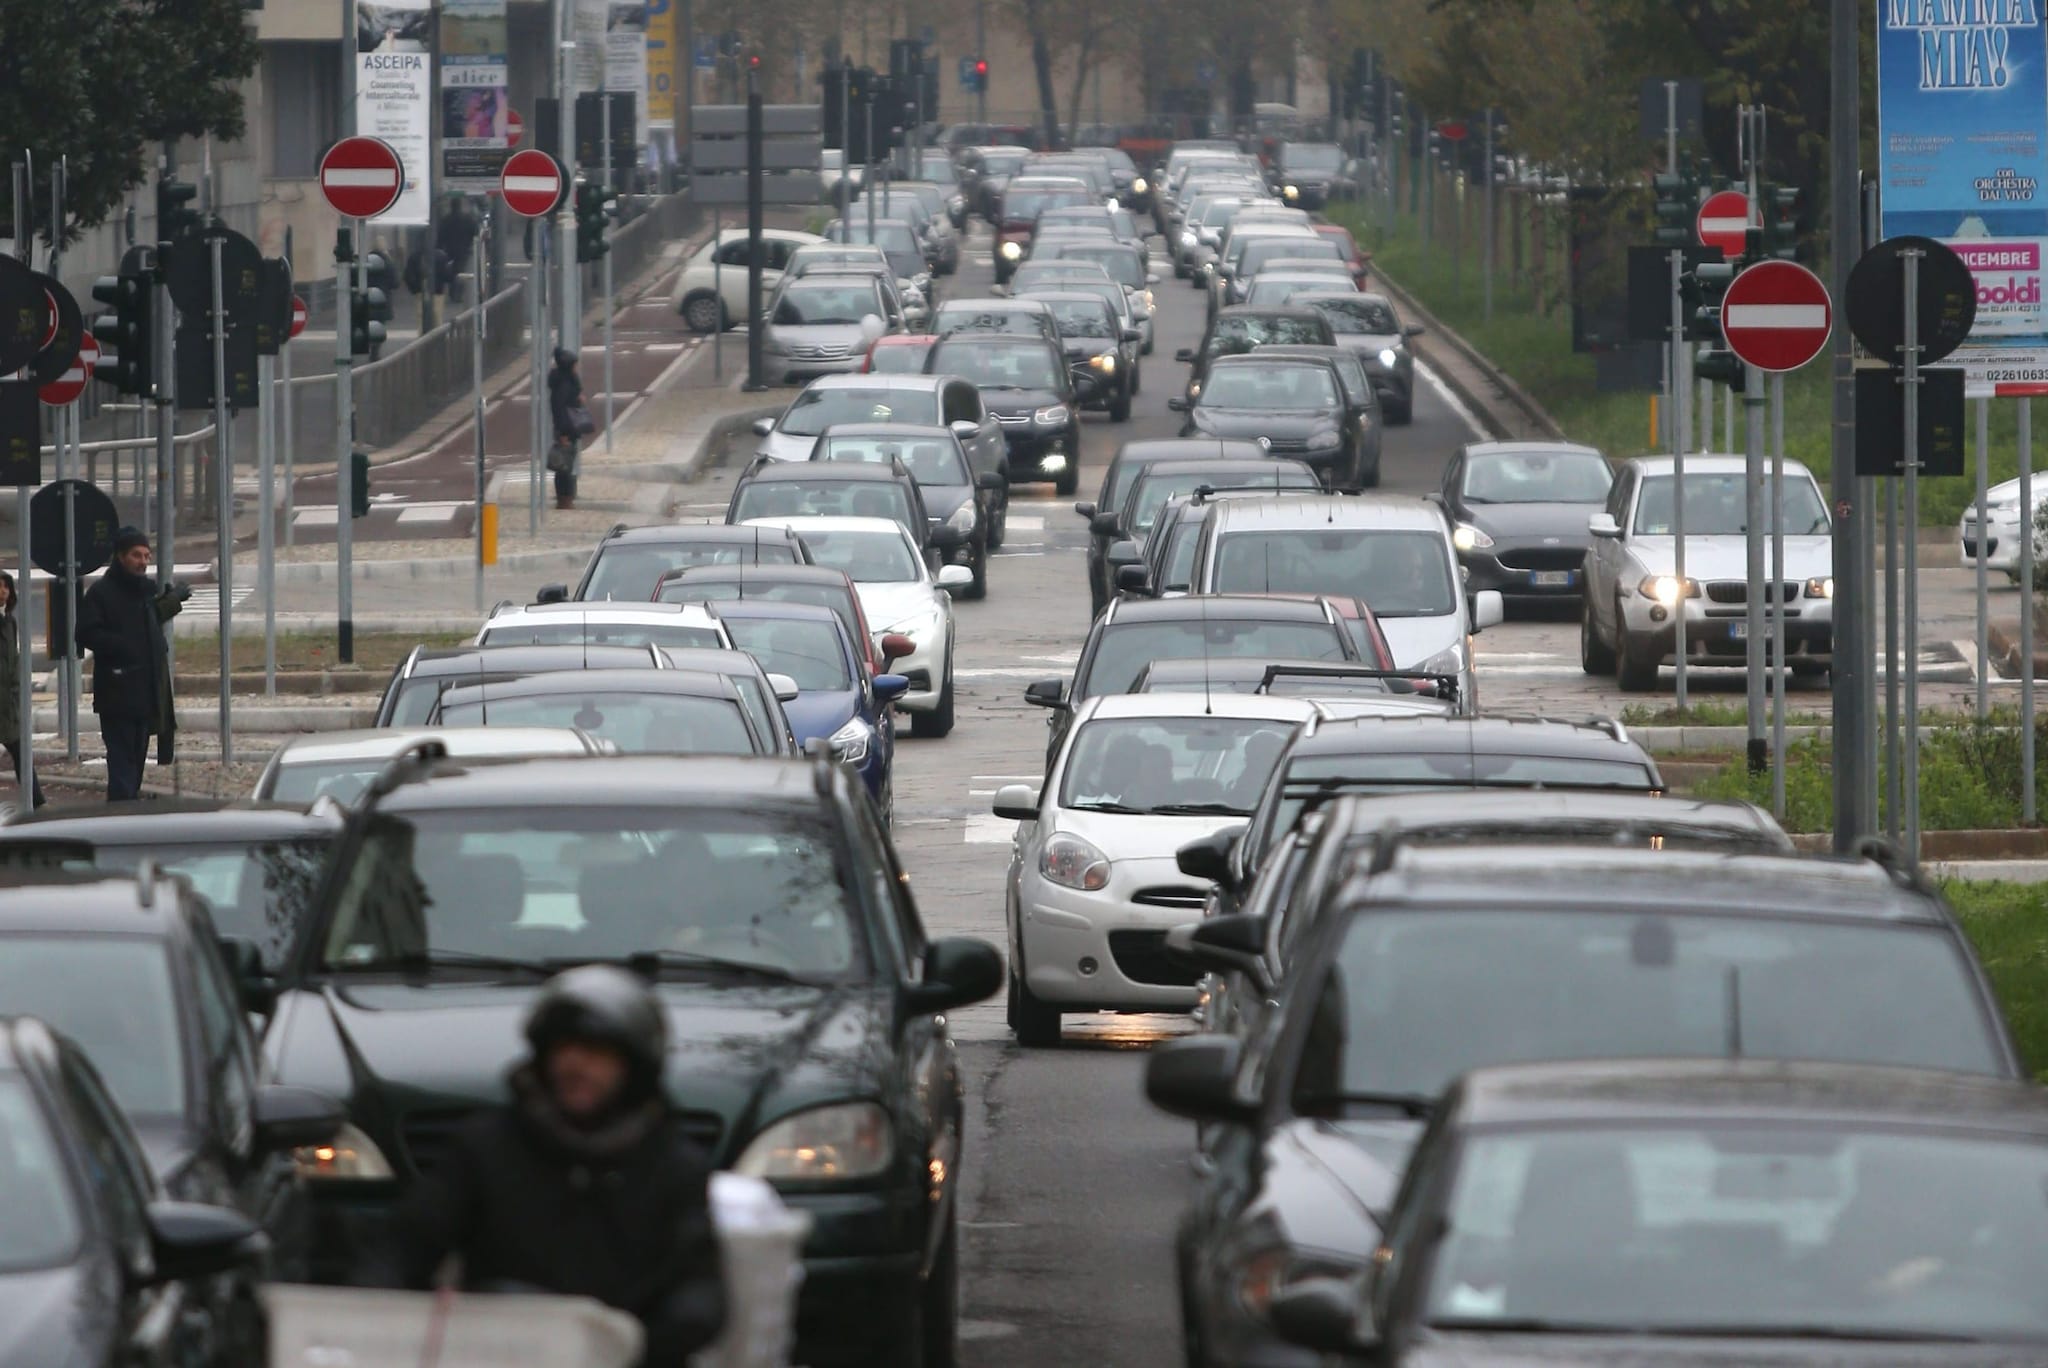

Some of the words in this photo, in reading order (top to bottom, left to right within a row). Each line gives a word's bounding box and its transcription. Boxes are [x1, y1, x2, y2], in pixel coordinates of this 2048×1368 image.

[364, 55, 422, 69] ASCEIPA
[1919, 26, 2009, 91] MIA!
[1996, 168, 2015, 178] con
[1974, 177, 2037, 190] ORCHESTRA
[1979, 189, 2001, 201] DAL
[2004, 189, 2033, 201] VIVO
